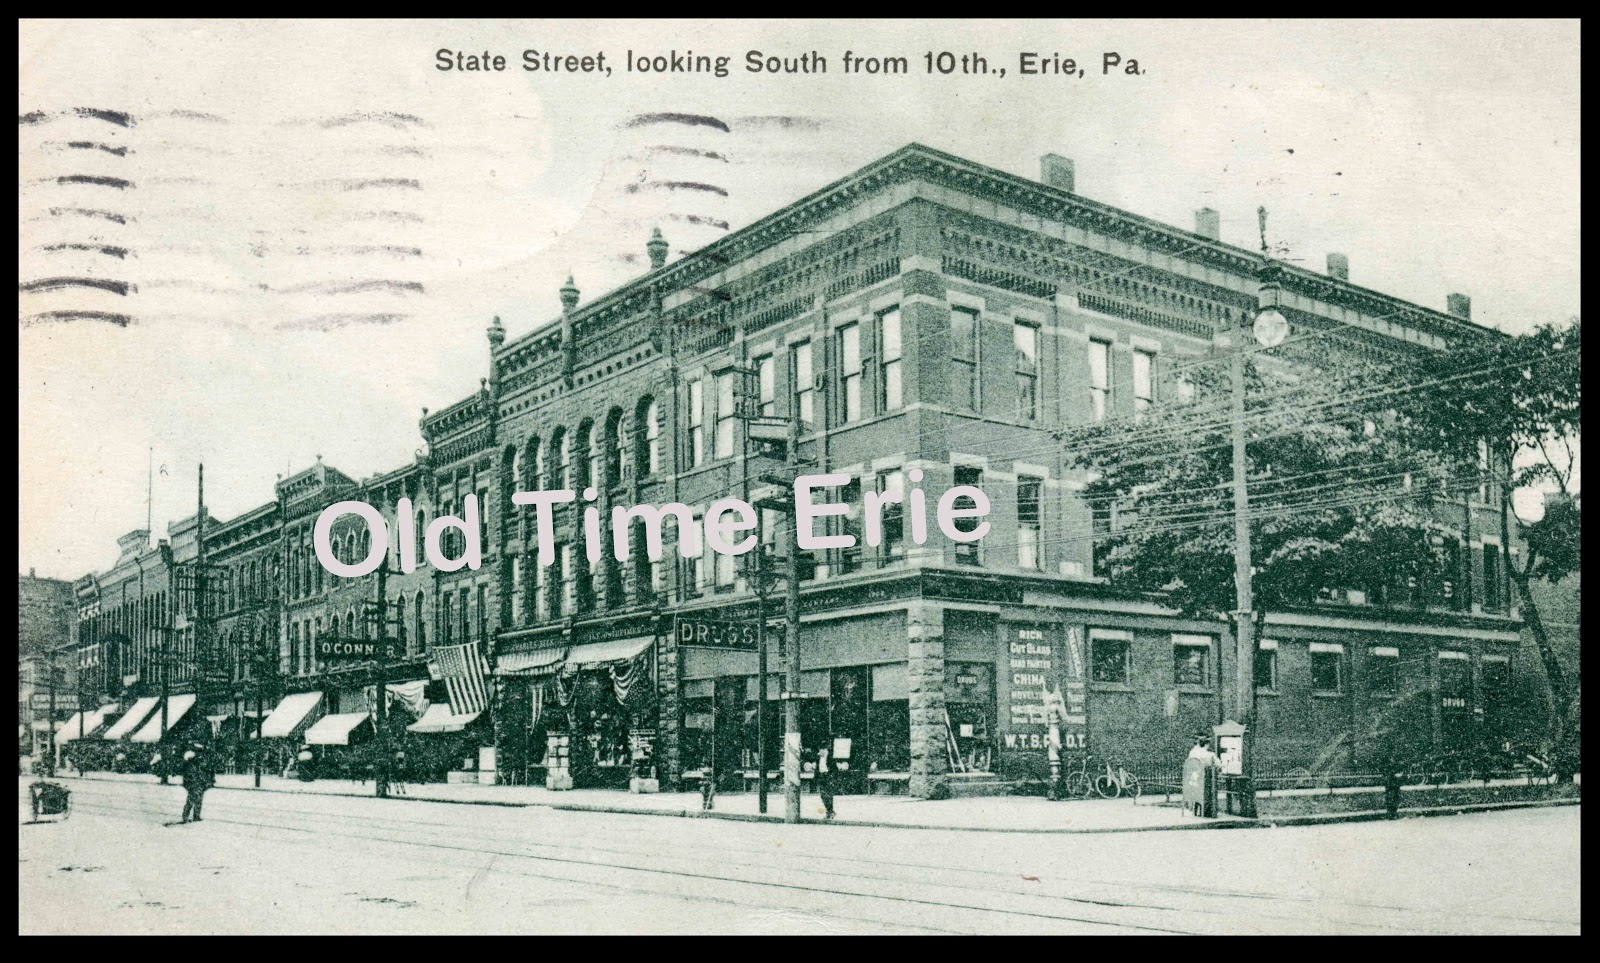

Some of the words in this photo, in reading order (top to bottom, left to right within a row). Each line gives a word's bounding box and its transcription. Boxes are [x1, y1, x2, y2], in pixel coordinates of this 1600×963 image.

[681, 622, 754, 645] DRUGS
[1018, 629, 1043, 640] RICH
[321, 641, 396, 659] O'CONNR
[1013, 673, 1044, 685] CHINA
